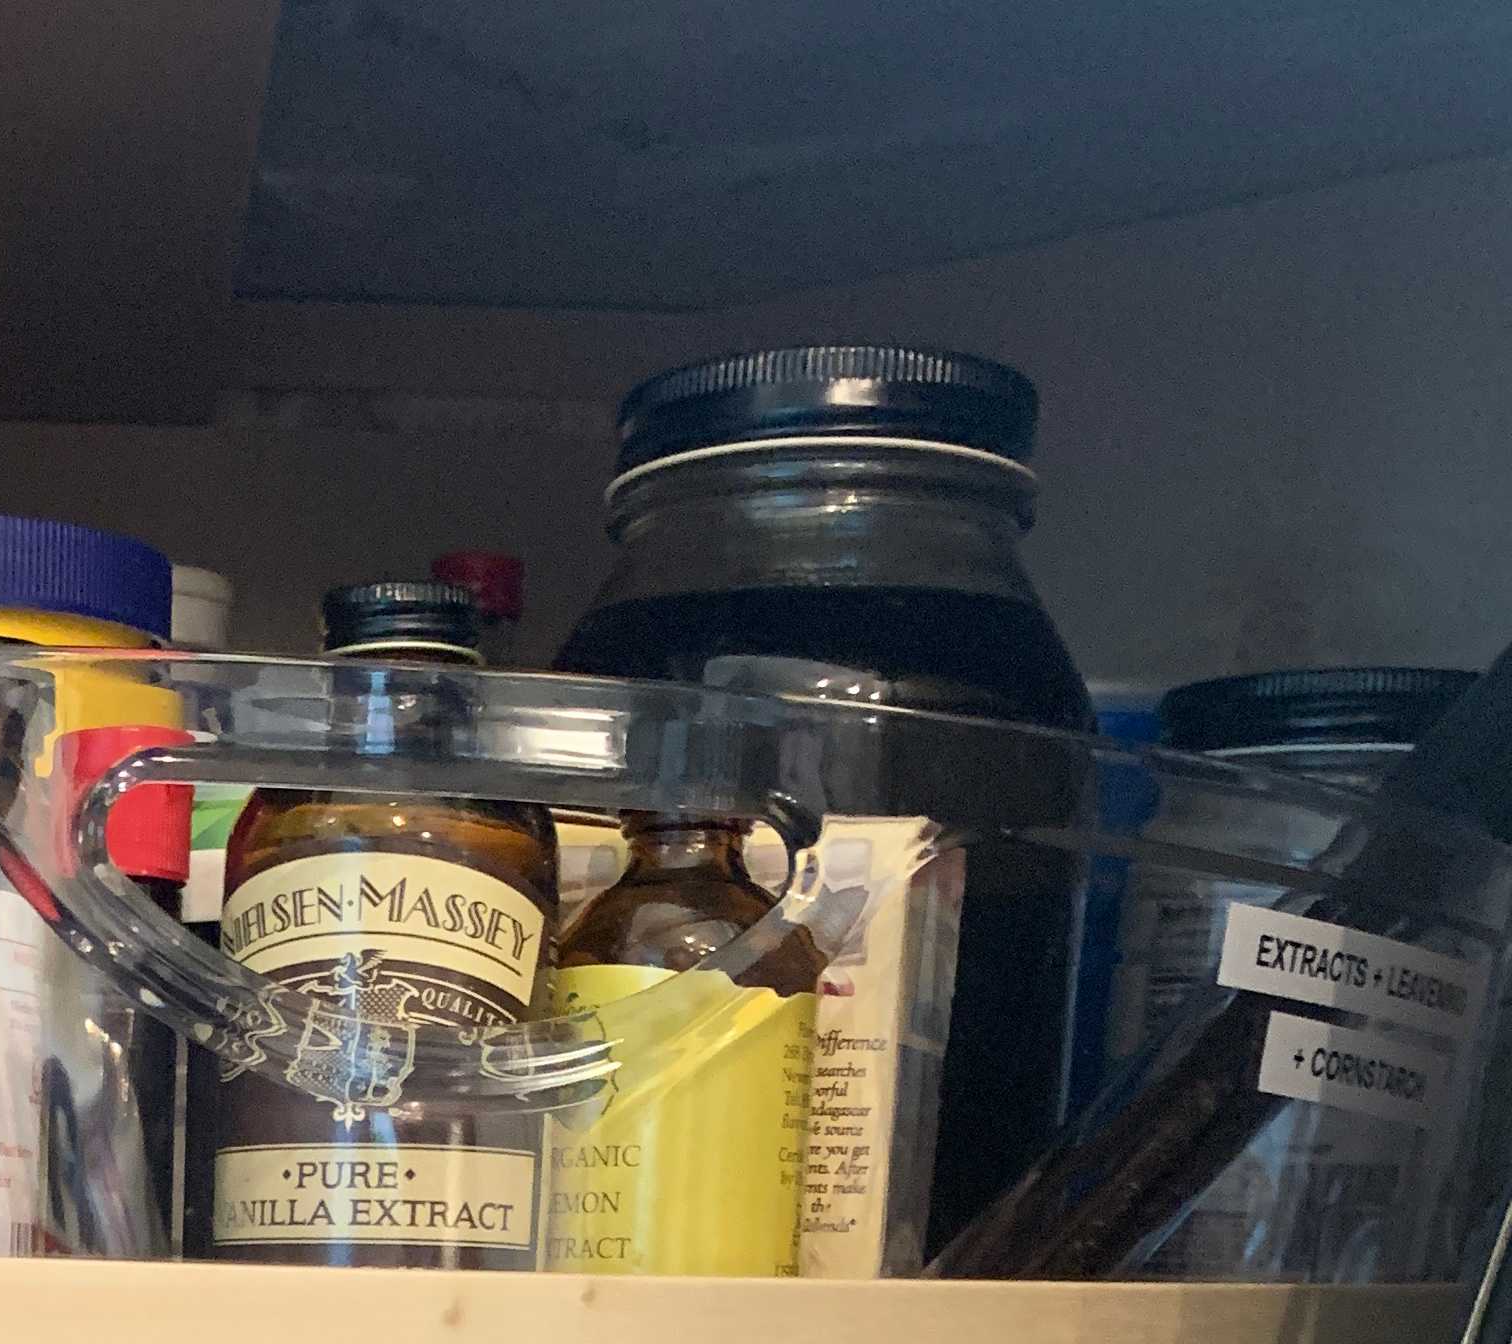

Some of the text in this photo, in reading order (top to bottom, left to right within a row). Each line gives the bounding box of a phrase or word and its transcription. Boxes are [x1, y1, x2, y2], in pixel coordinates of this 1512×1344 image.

[1256, 934, 1369, 989] EXTRACTS
[550, 1144, 642, 1169] RGANIC
[225, 1199, 515, 1232] ANILLA EXTRACT
[548, 1191, 622, 1214] EMON
